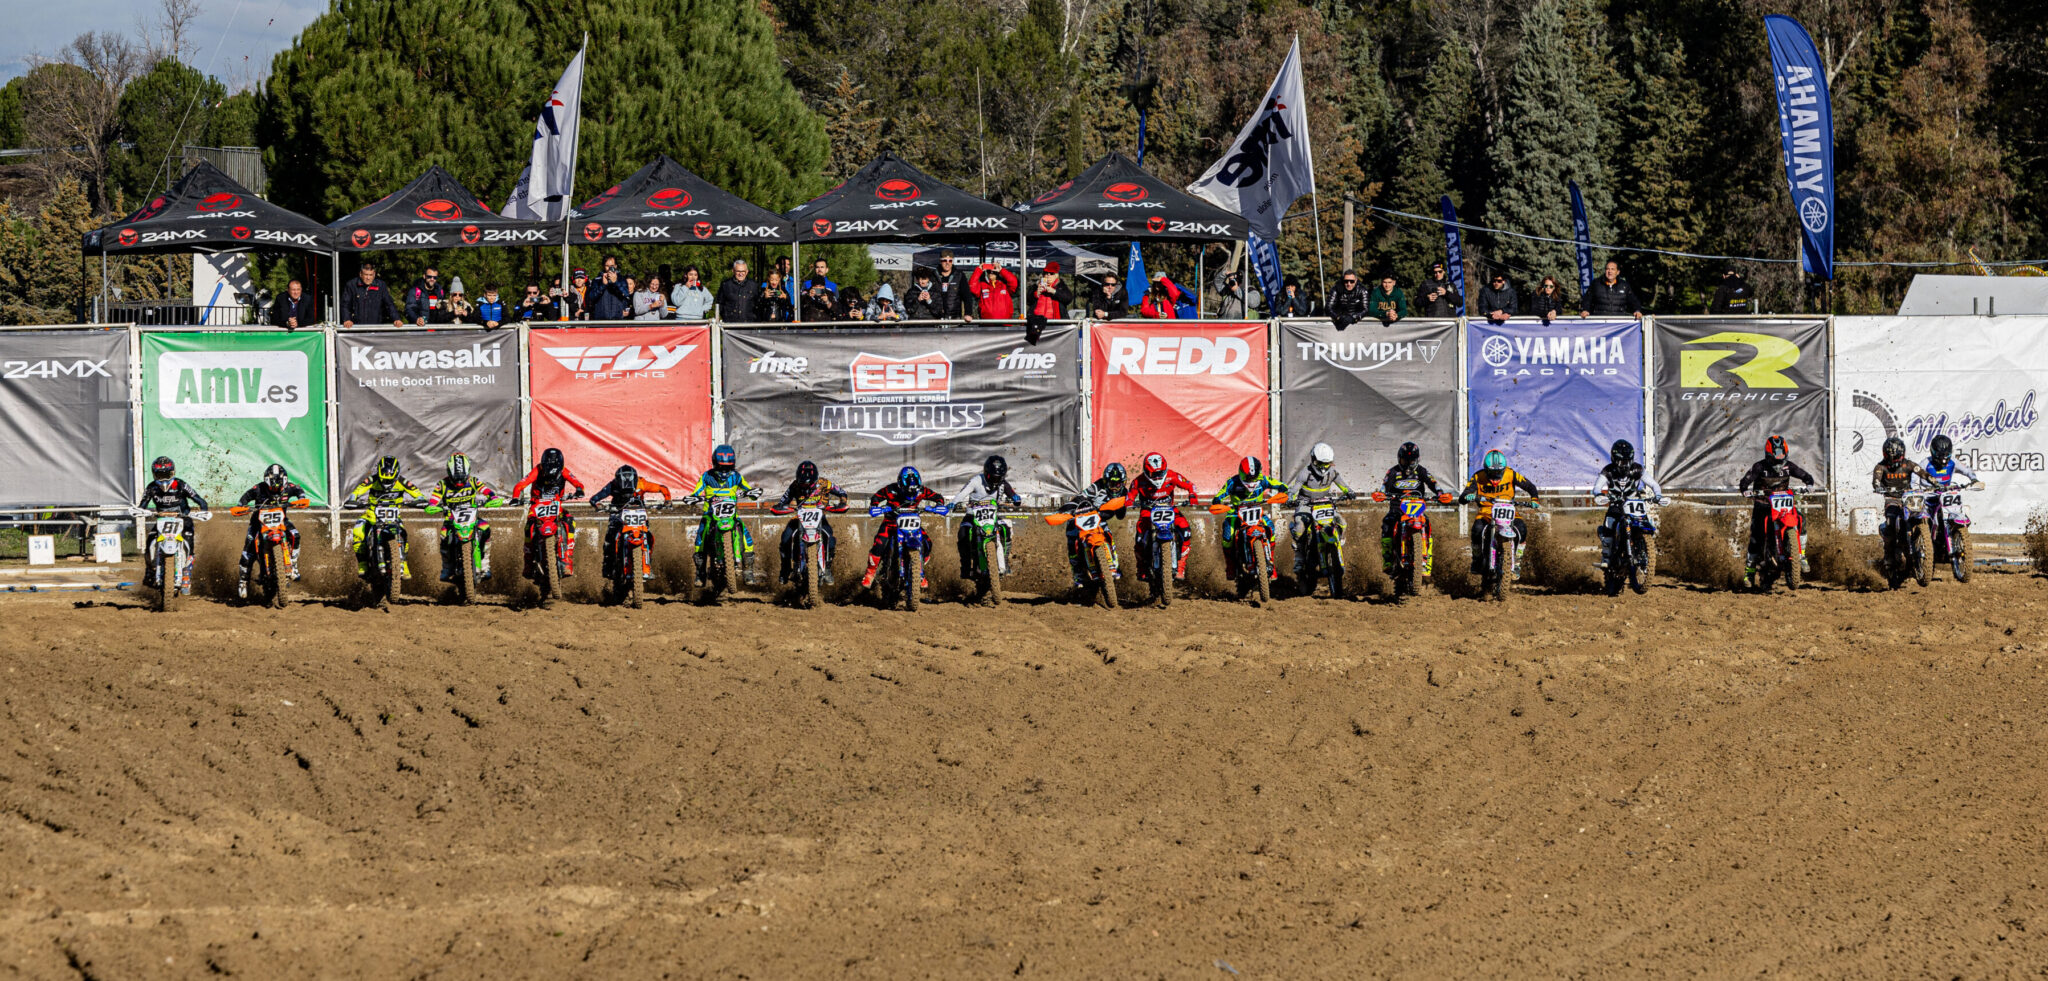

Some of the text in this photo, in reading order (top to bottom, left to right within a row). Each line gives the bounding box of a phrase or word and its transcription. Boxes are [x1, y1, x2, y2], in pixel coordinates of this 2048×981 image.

[835, 218, 900, 232] 24MX
[944, 217, 1009, 229] 24MX
[1061, 218, 1125, 231] 24MX
[1168, 220, 1232, 236] 24MX
[141, 229, 208, 243] 24MX
[373, 231, 439, 245] 24MX
[483, 229, 548, 241] 24MX
[606, 226, 671, 239] 24MX
[715, 225, 781, 238] 24MX
[253, 230, 318, 247] 24MX
[351, 343, 501, 371] Kawasaki
[1106, 336, 1251, 375] REDD
[1297, 342, 1413, 363] TRIUMPH
[1514, 336, 1626, 365] YAMAHA
[541, 344, 699, 372] FLY
[749, 351, 808, 373] rfme
[997, 347, 1057, 370] rfme
[3, 359, 113, 379] 24MX
[575, 371, 665, 380] RACING
[1494, 368, 1618, 376] RACING
[359, 374, 495, 388] Let the Good Times Roll
[856, 363, 947, 390] ESP
[857, 394, 946, 404] CAMPEONATO DE ESPAÑA
[1681, 392, 1800, 401] GRAPHICS
[822, 404, 984, 431] MOTOCROSS
[1906, 390, 2038, 452] Motoclub
[1943, 494, 1962, 507] 84
[537, 505, 558, 518] 219
[1405, 502, 1423, 515] 17
[1493, 507, 1514, 521] 180
[1626, 502, 1646, 514] 14
[263, 512, 281, 524] 25
[457, 510, 473, 523] 5
[803, 511, 820, 523] 124
[1082, 515, 1096, 528] 4
[1152, 510, 1174, 522] 92
[1241, 508, 1261, 522] 111
[899, 518, 920, 528] 115
